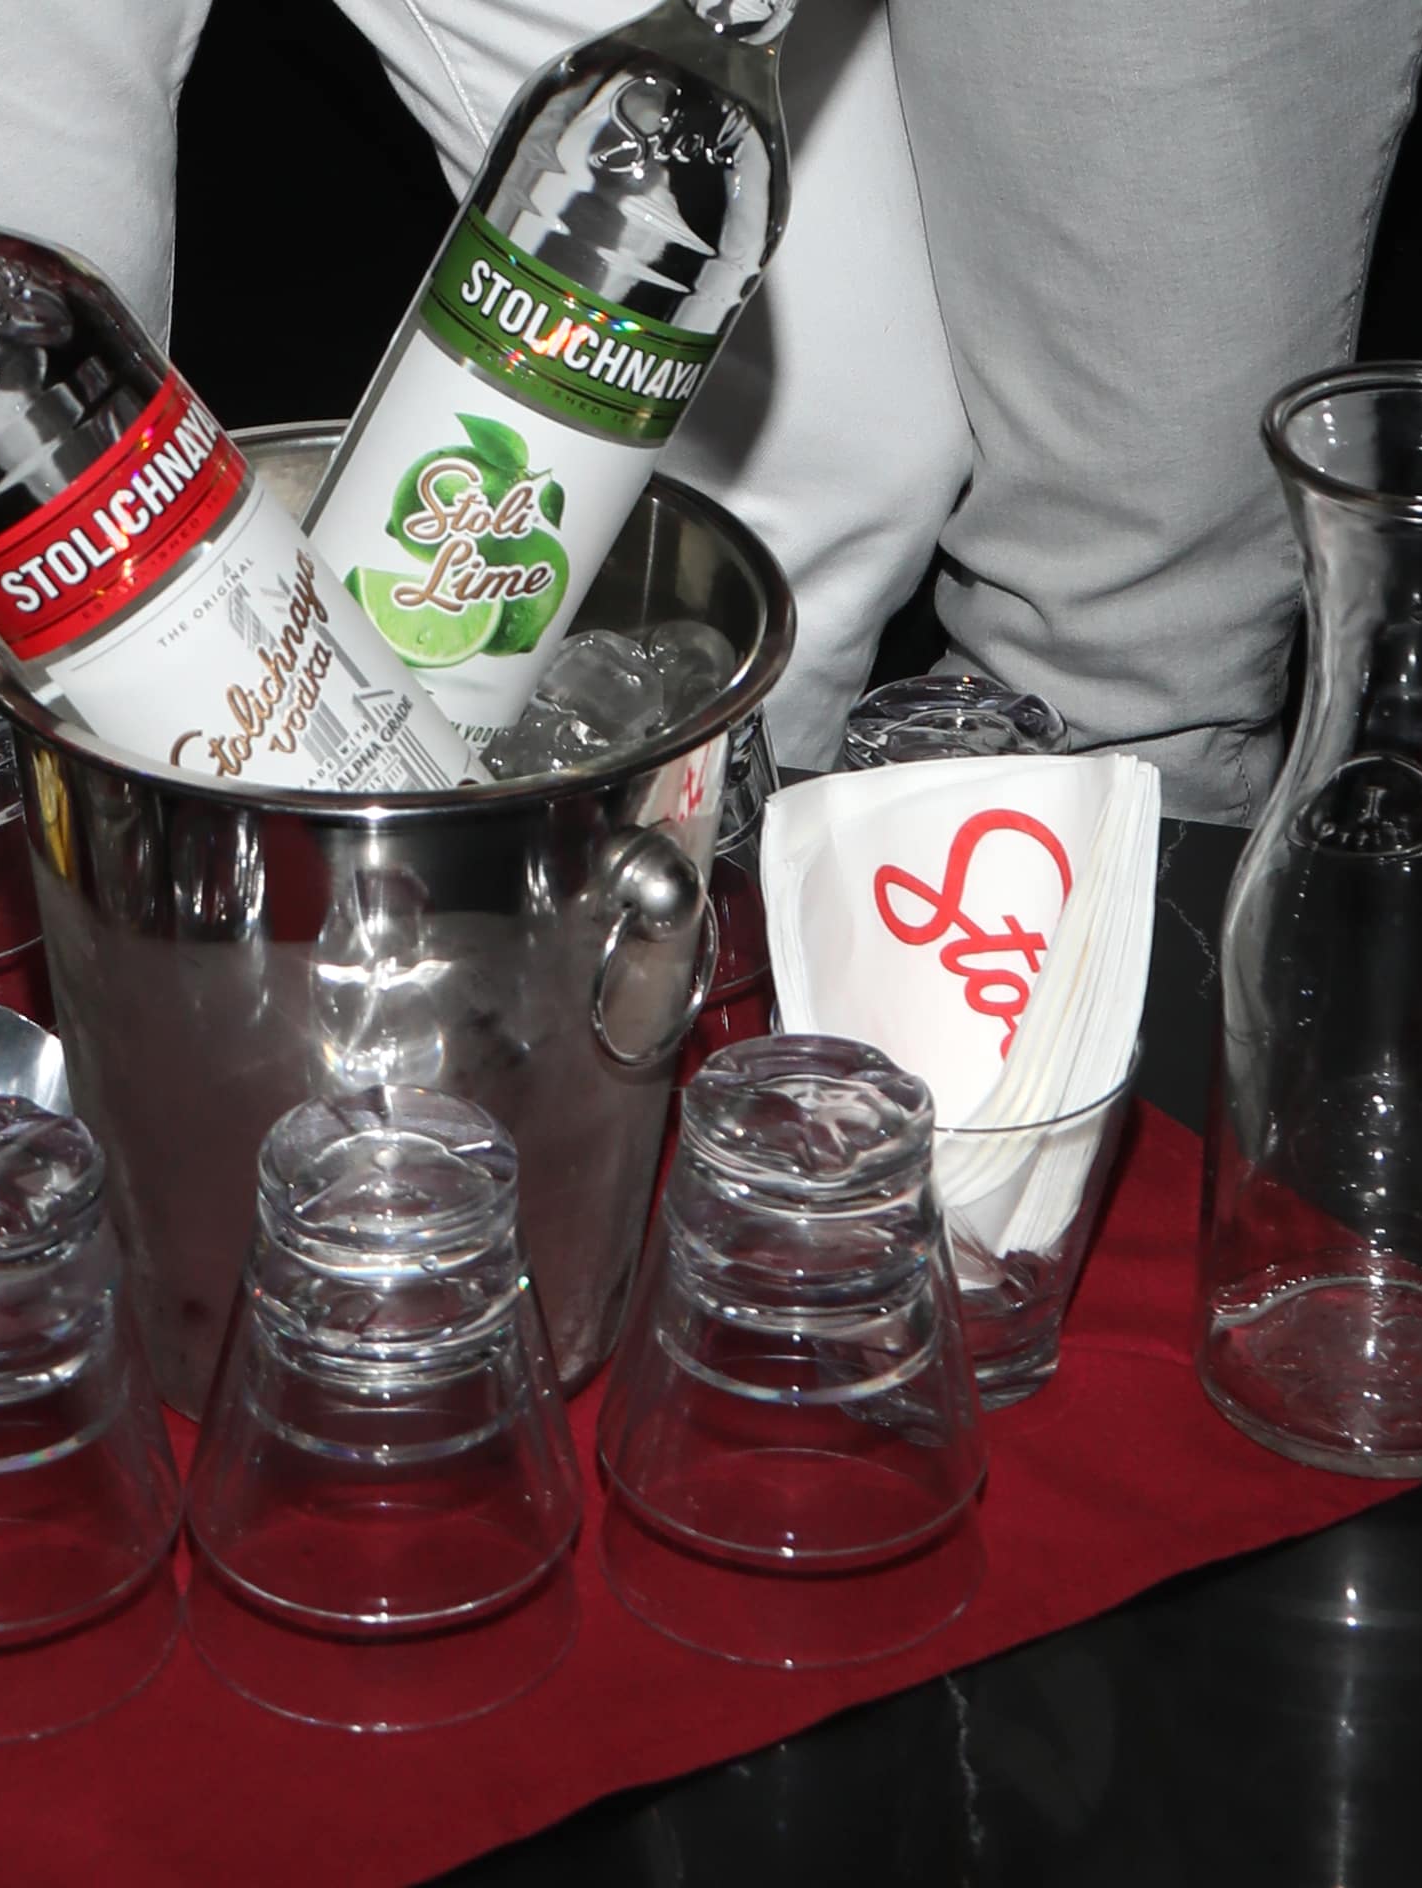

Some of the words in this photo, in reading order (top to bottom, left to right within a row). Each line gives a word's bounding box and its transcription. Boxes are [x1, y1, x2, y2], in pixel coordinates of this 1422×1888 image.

[460, 258, 703, 401] STOLICHNAYA
[0, 401, 220, 612] STOLICHNAYA
[404, 460, 535, 542] Stoli
[158, 617, 189, 649] THE
[192, 557, 256, 620] ORIGINAL
[393, 538, 553, 613] Lime
[268, 640, 333, 755] vodka
[336, 739, 383, 792] ALPHA
[379, 692, 415, 744] GRADE
[339, 722, 371, 756] WITH
